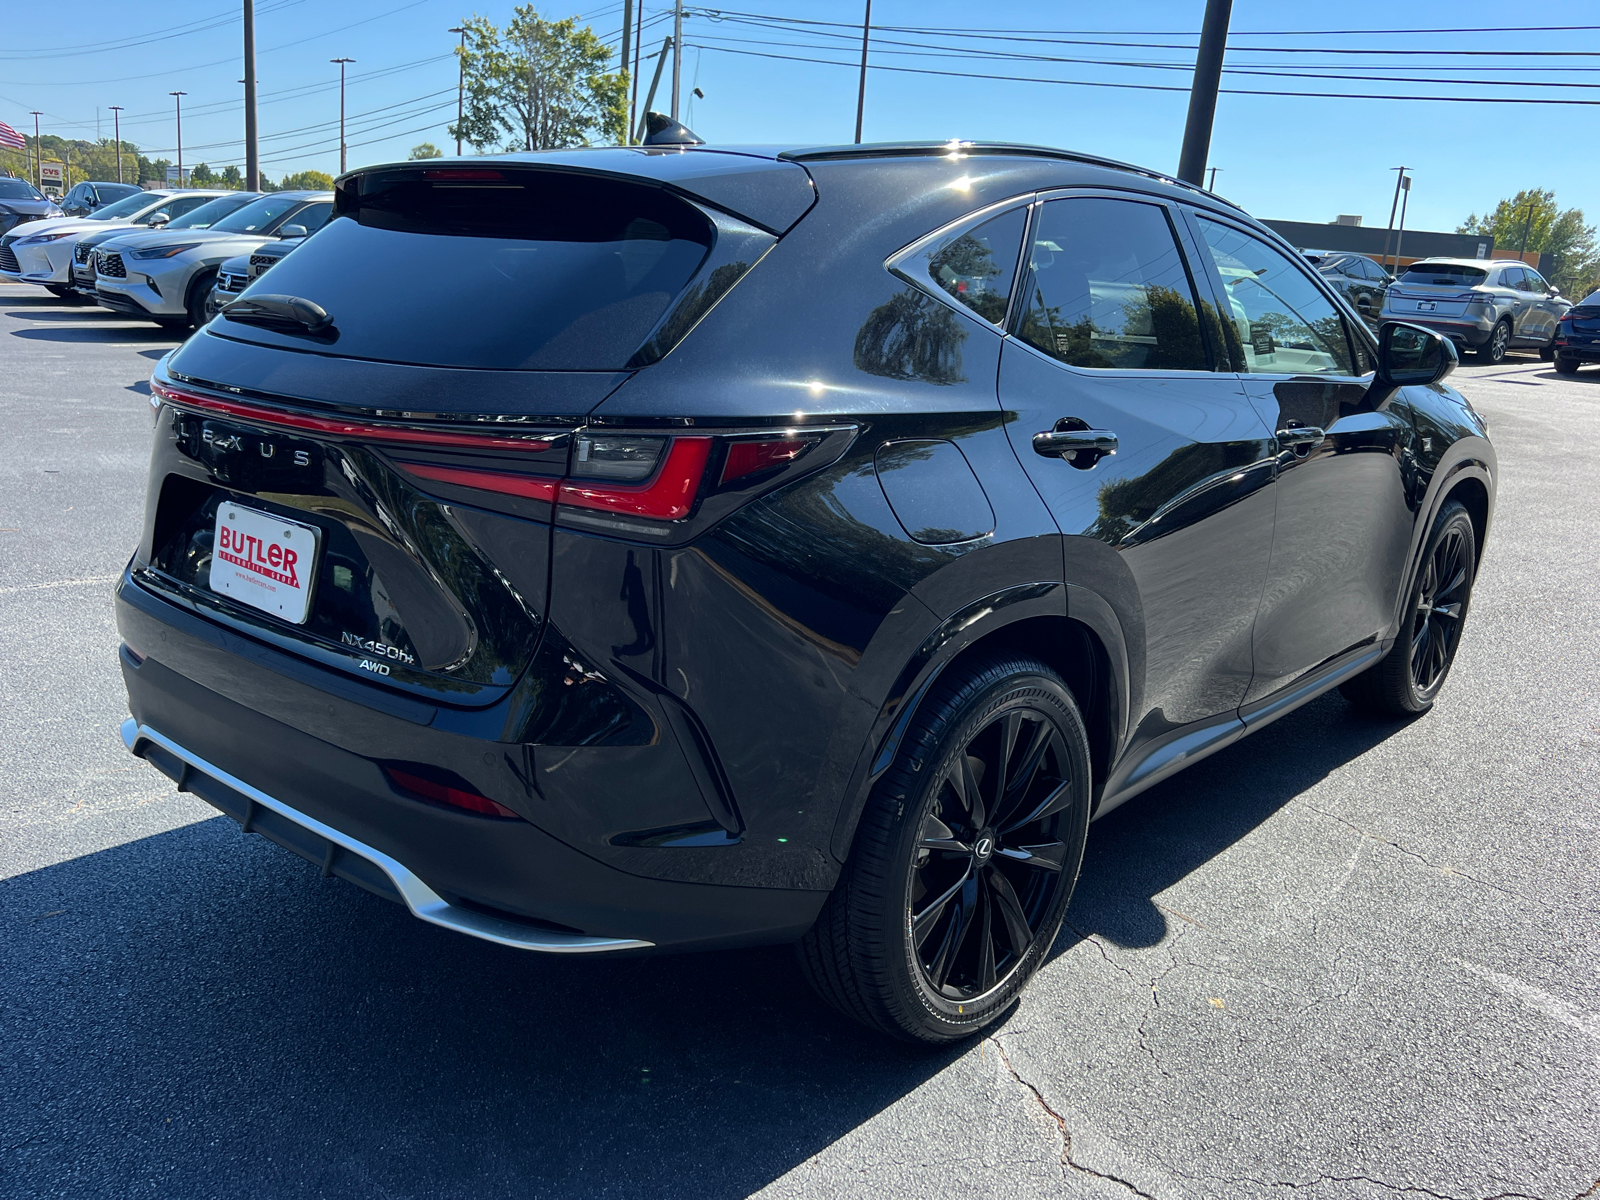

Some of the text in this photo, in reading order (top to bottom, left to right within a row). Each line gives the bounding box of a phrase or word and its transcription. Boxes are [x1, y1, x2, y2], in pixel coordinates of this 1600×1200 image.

[179, 422, 309, 467] LEXUS
[218, 550, 299, 588] AUTOMOTIVE GROUP
[358, 659, 390, 676] AWD
